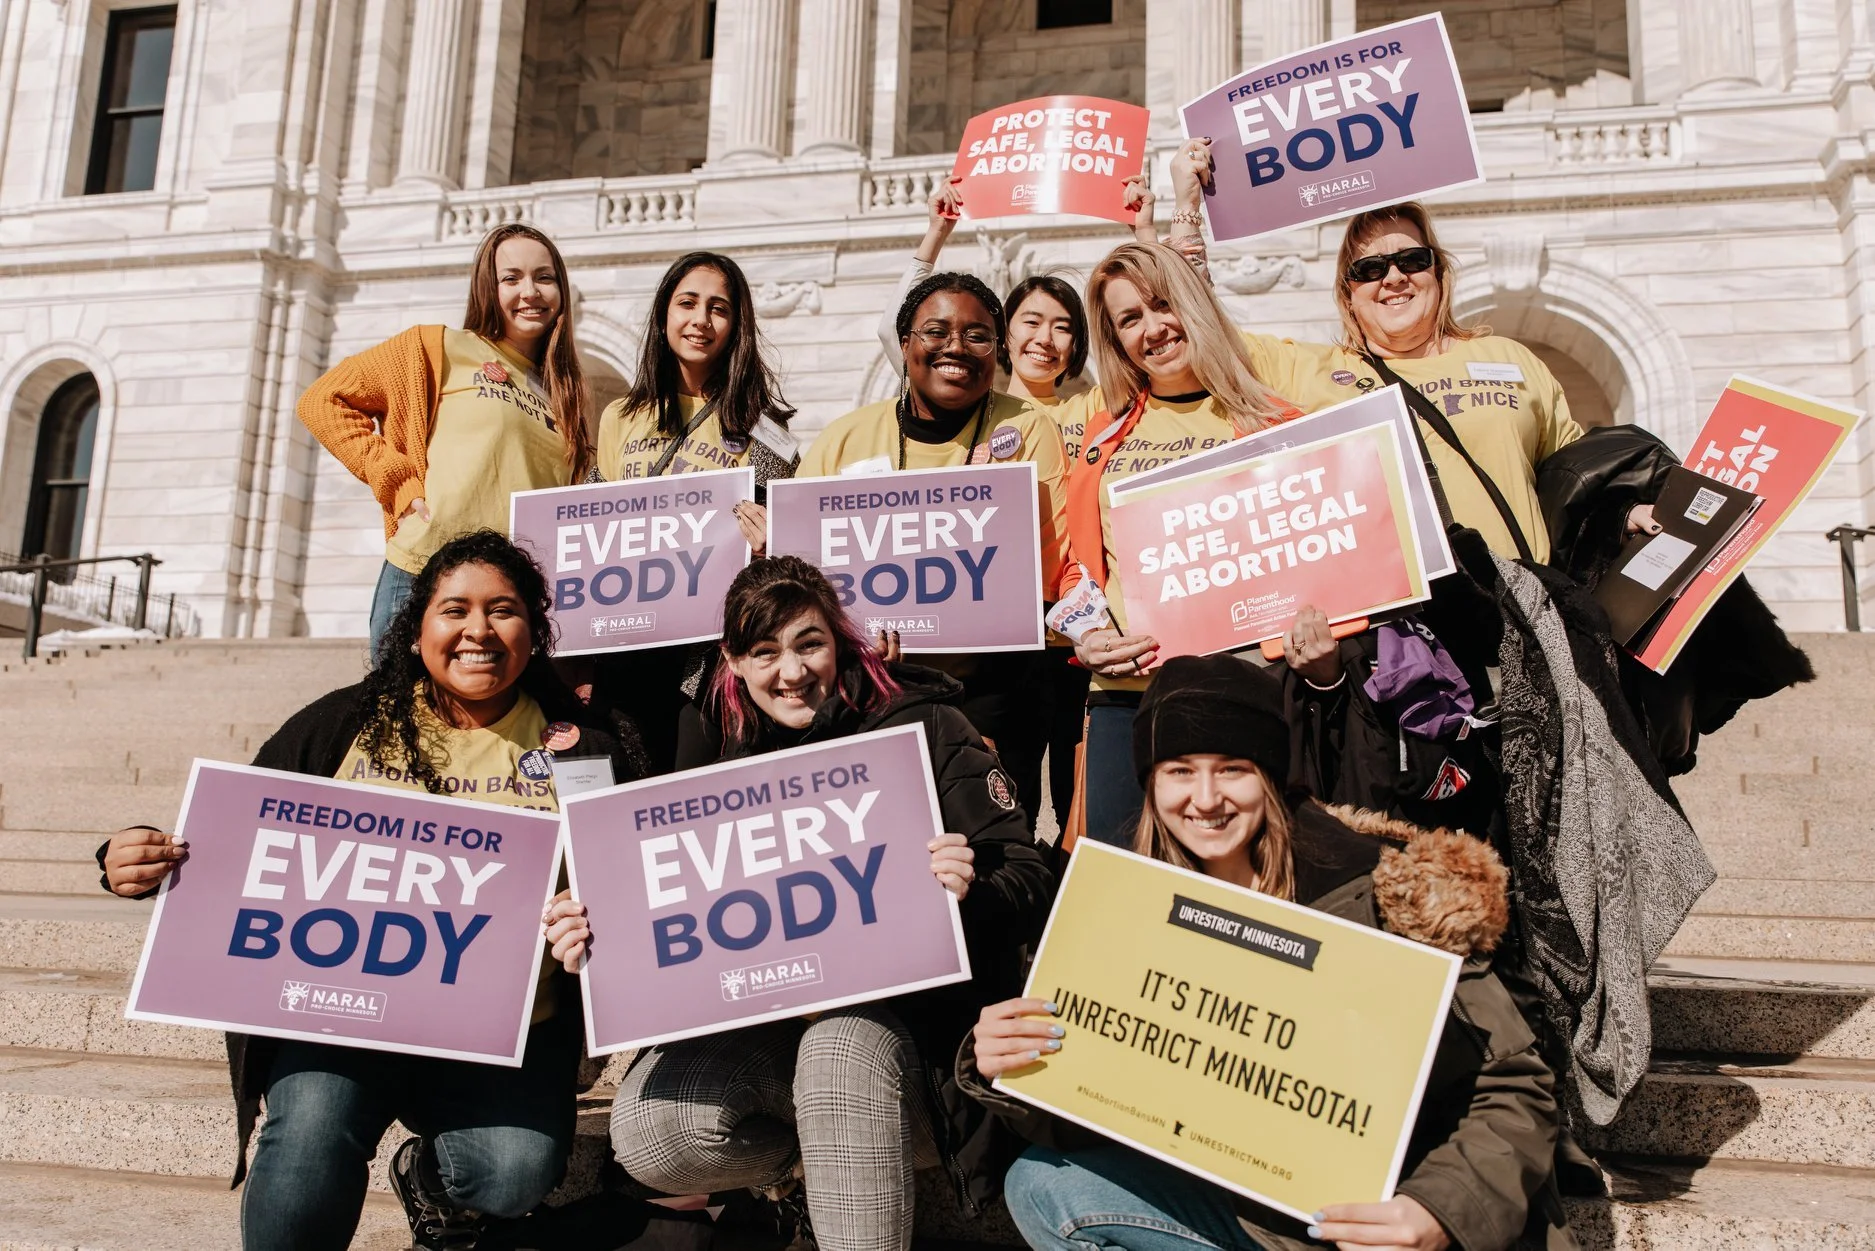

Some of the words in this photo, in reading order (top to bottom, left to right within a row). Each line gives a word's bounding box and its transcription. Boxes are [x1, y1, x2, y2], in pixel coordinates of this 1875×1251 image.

[1228, 60, 1330, 102] FREEDOM
[1334, 53, 1354, 70] IS
[1359, 41, 1403, 66] FOR
[992, 108, 1112, 134] PROTECT
[1232, 57, 1413, 146] EVERY
[967, 132, 1036, 158] SAFE,
[1044, 130, 1128, 158] LEGAL
[1245, 92, 1419, 188] BODY
[970, 152, 1114, 176] ABORTION
[1321, 176, 1369, 194] NARAL
[477, 386, 512, 403] ARE
[514, 397, 540, 420] NOT
[1471, 392, 1518, 410] NICE
[623, 438, 694, 456] ABORTN
[695, 442, 739, 468] BANS
[992, 432, 1016, 448] EVERY
[993, 438, 1016, 452] BODY
[1118, 437, 1196, 452] BORTION
[556, 497, 648, 520] FREEDOM
[652, 494, 669, 510] IS
[674, 490, 713, 508] FOR
[819, 490, 920, 512] FREEDOM
[926, 488, 944, 504] IS
[950, 485, 992, 504] FOR
[1162, 466, 1326, 537] PROTECT
[556, 510, 718, 573] EVERY
[820, 506, 999, 568] EVERY
[1138, 527, 1240, 574] SAFE,
[1248, 490, 1367, 544] LEGAL
[555, 546, 716, 612] BODY
[823, 546, 998, 607] BODY
[1159, 524, 1358, 604] ABORTION
[1246, 590, 1278, 606] Planned
[1248, 594, 1296, 614] Parenthood
[610, 616, 652, 628] NARAL
[887, 620, 934, 630] NARAL
[352, 758, 478, 794] ABORON
[486, 776, 549, 798] BANS
[634, 782, 771, 831] FREEDOM
[780, 776, 804, 798] IS
[812, 763, 870, 794] FOR
[259, 797, 405, 838] FREEDOM
[412, 820, 436, 844] IS
[444, 826, 503, 853] FOR
[241, 828, 506, 906] EVERY
[640, 790, 881, 910] EVERY
[652, 843, 888, 968] BODY
[227, 908, 493, 985] BODY
[1178, 904, 1242, 938] UNRESTRICT
[1242, 924, 1306, 960] MINNESOTA
[750, 960, 815, 984] NARAL
[310, 1003, 344, 1012] PRO-CHOICE
[346, 1008, 378, 1017] MINNESOTA
[312, 990, 378, 1011] NARAL
[1140, 968, 1191, 1012] IT'S
[1196, 987, 1259, 1039] TIME
[1263, 1011, 1296, 1051] TO
[1052, 986, 1202, 1070] UNRESTRICT
[1203, 1046, 1372, 1138] MINNESOTA!
[1076, 1085, 1166, 1129] #NoAbortionBansMN
[1189, 1132, 1294, 1181] UNRESTRICTMN.ORG
